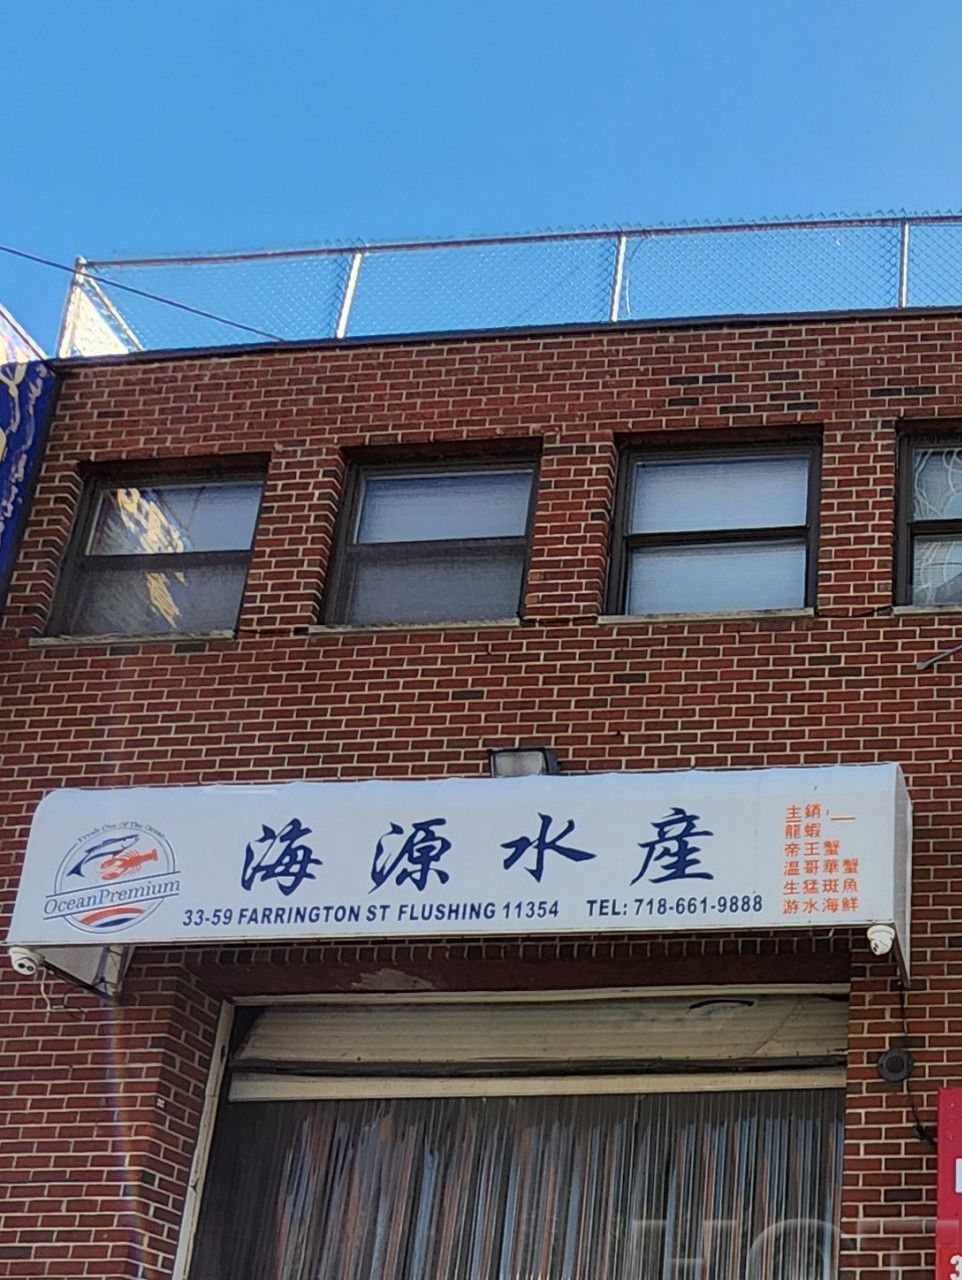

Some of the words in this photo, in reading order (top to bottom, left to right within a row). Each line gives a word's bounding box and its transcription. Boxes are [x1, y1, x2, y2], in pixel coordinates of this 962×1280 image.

[43, 879, 181, 915] OceanPremium
[182, 908, 233, 926] 33-59
[237, 905, 361, 925] FARRINGTON
[366, 905, 391, 922] ST
[397, 902, 496, 921] FLUSHING
[502, 900, 560, 919] 11354
[586, 899, 628, 917] TEL:
[633, 895, 763, 916] 718-661-9888
